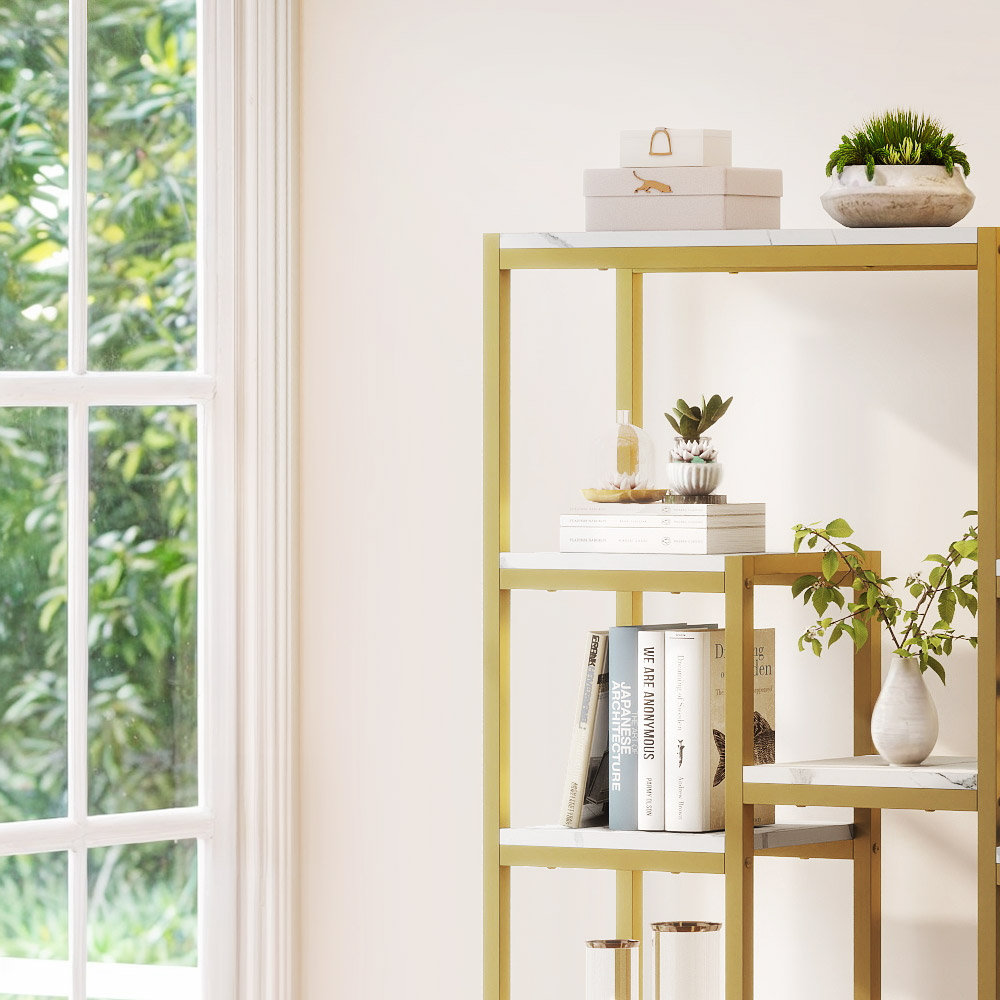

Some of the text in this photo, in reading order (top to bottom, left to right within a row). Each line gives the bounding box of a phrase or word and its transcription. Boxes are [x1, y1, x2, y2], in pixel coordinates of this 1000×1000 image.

[611, 680, 621, 791] ARCHITECTURE
[620, 682, 632, 755] JAPANESE
[643, 647, 655, 760] WE ARE ANONYMOUS
[631, 745, 638, 755] OF
